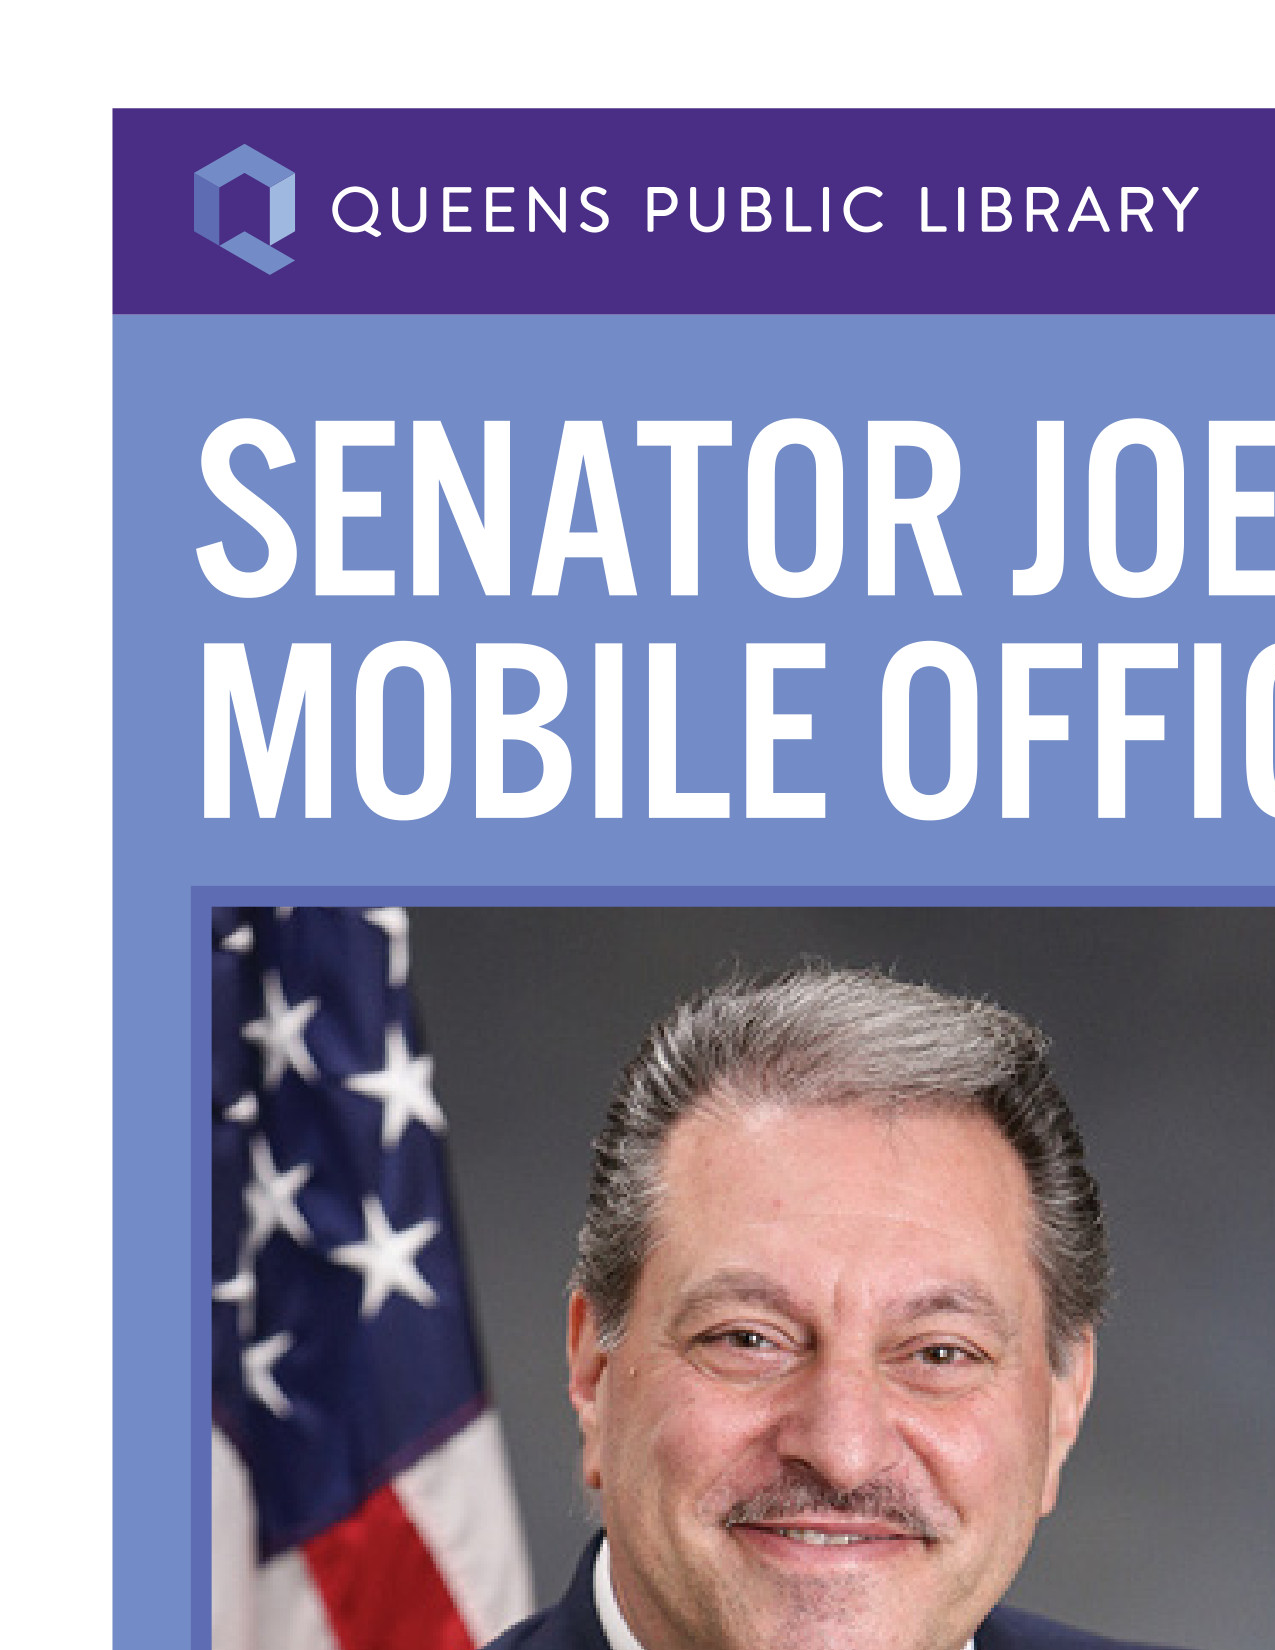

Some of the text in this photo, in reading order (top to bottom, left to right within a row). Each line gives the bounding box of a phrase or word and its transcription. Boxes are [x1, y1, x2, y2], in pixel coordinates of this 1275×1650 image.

[332, 186, 1199, 237] QUEENS PUBLIC LIBRARY
[196, 418, 962, 598] SENATOR
[204, 641, 825, 820] MOBILE
